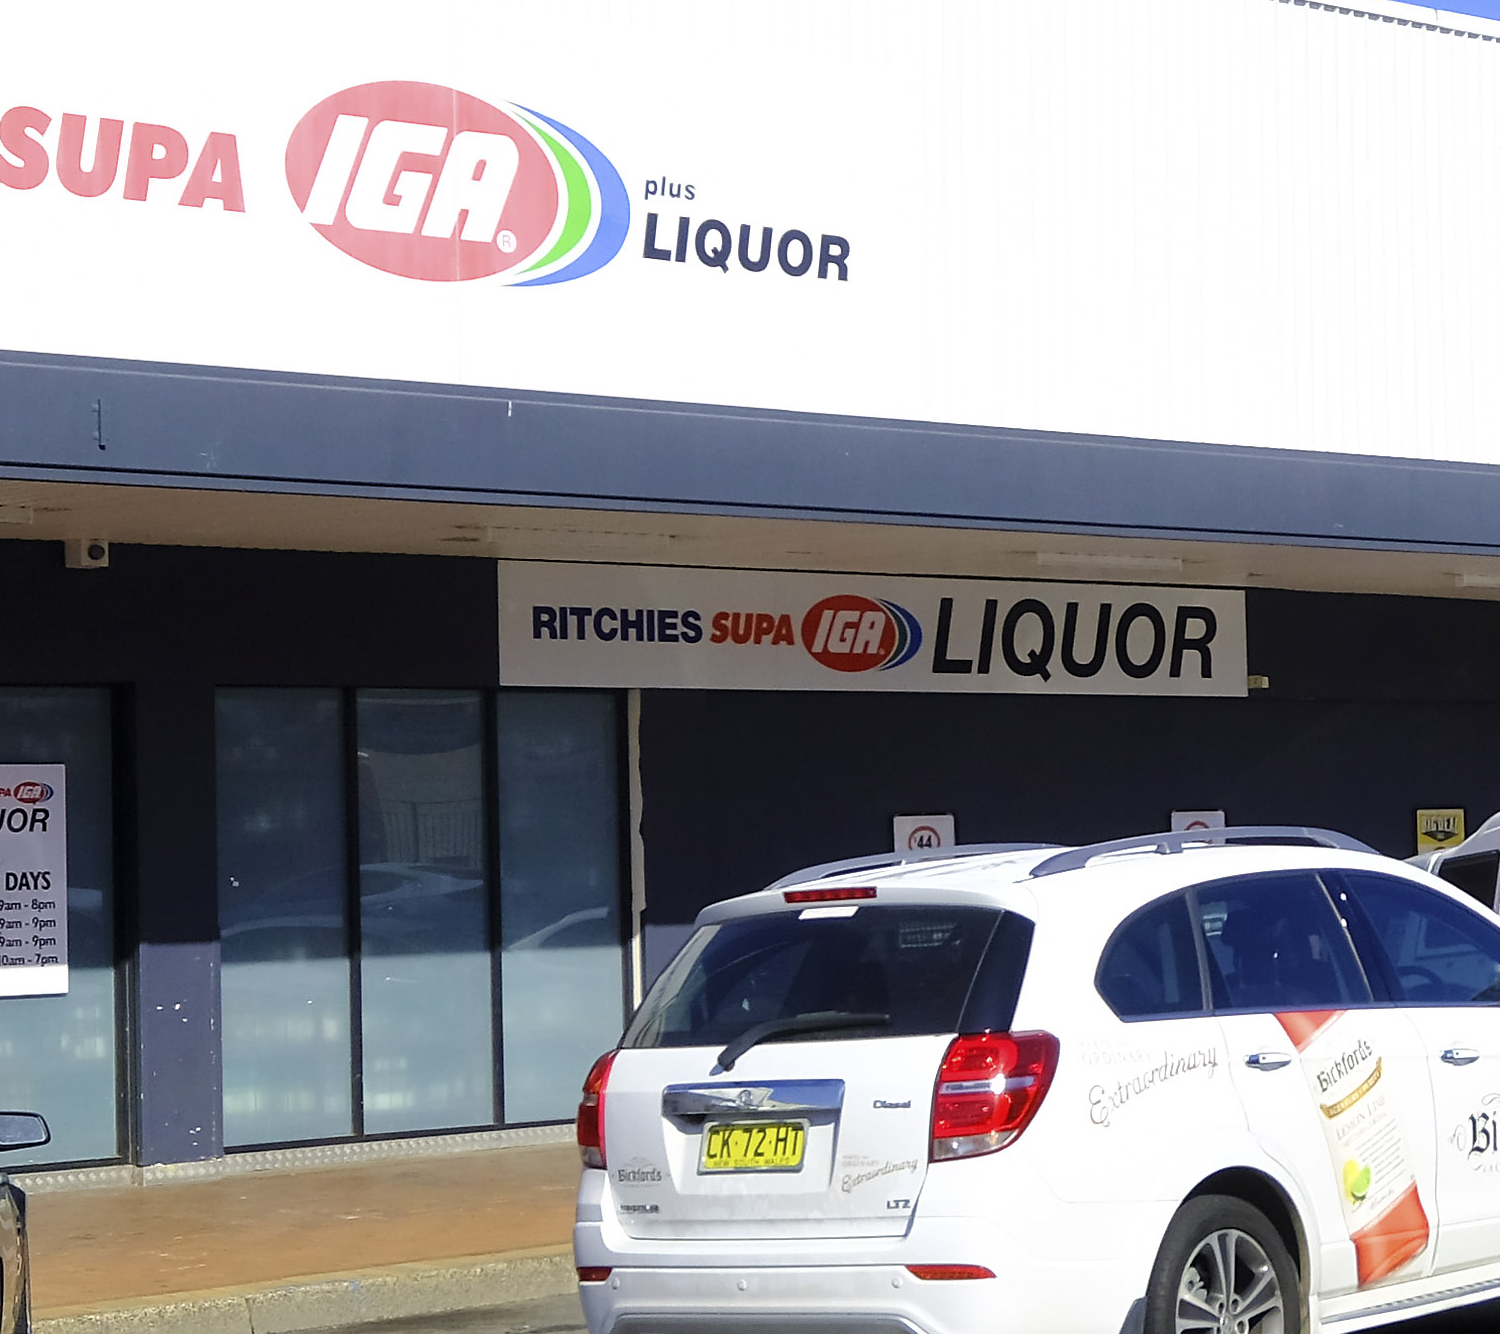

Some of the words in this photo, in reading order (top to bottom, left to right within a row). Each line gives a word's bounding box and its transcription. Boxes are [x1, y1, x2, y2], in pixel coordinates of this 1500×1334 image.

[301, 113, 520, 243] IGA
[644, 175, 697, 203] plus
[642, 212, 852, 282] LIQUOR
[531, 605, 702, 644] RITCHIES
[710, 611, 795, 647] SUPA
[810, 608, 883, 656] IGA
[932, 596, 1218, 682] LIQUOR
[5, 870, 52, 892] DAYS
[31, 898, 56, 913] 8pm
[32, 916, 57, 931] 9pm
[32, 934, 57, 950] 9pm
[1088, 1046, 1219, 1128] Extraordinary
[713, 1158, 730, 1167] NEW
[734, 1158, 760, 1166] SOUTH
[764, 1156, 790, 1165] WALES
[887, 1199, 912, 1210] LTZ
